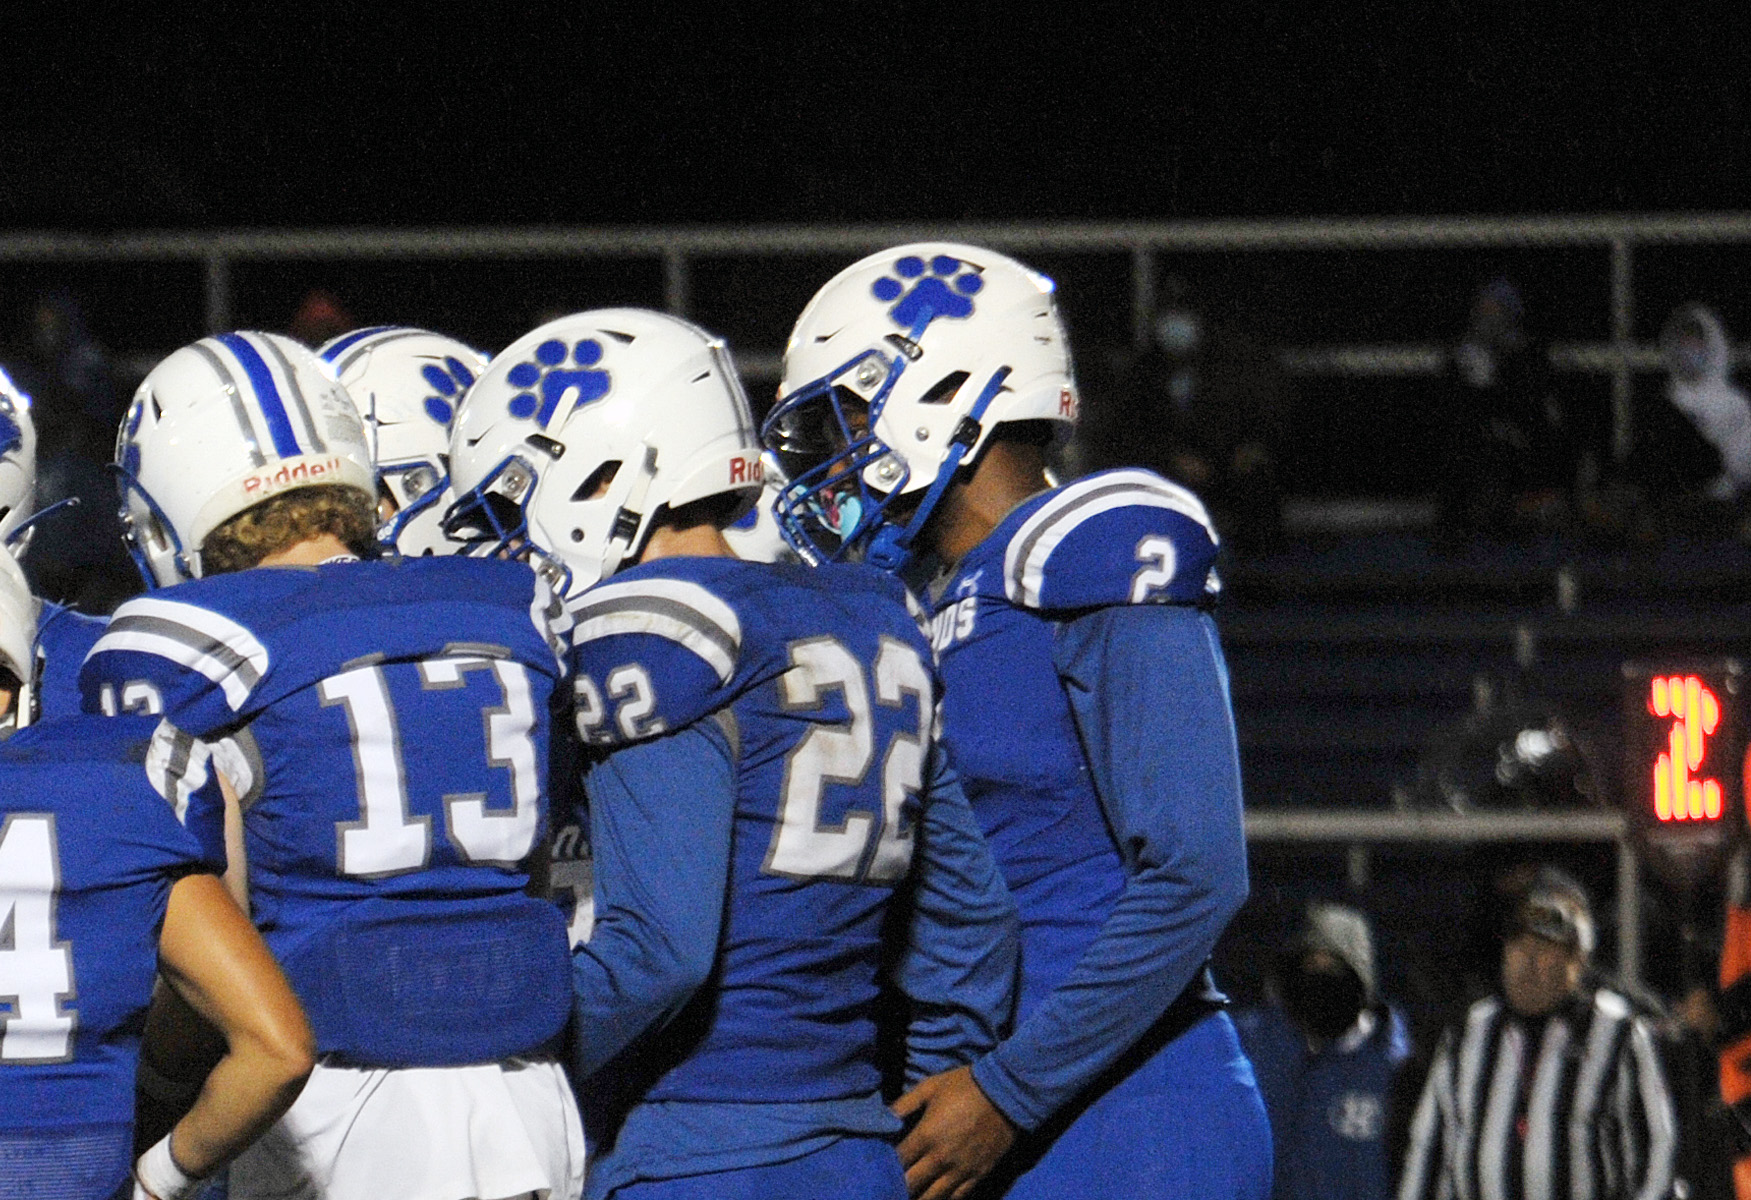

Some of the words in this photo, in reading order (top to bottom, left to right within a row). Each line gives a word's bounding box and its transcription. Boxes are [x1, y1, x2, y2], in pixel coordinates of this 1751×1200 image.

[1130, 534, 1177, 603] 2
[316, 642, 539, 880] 13
[759, 633, 934, 880] 22
[1651, 675, 1722, 821] 2
